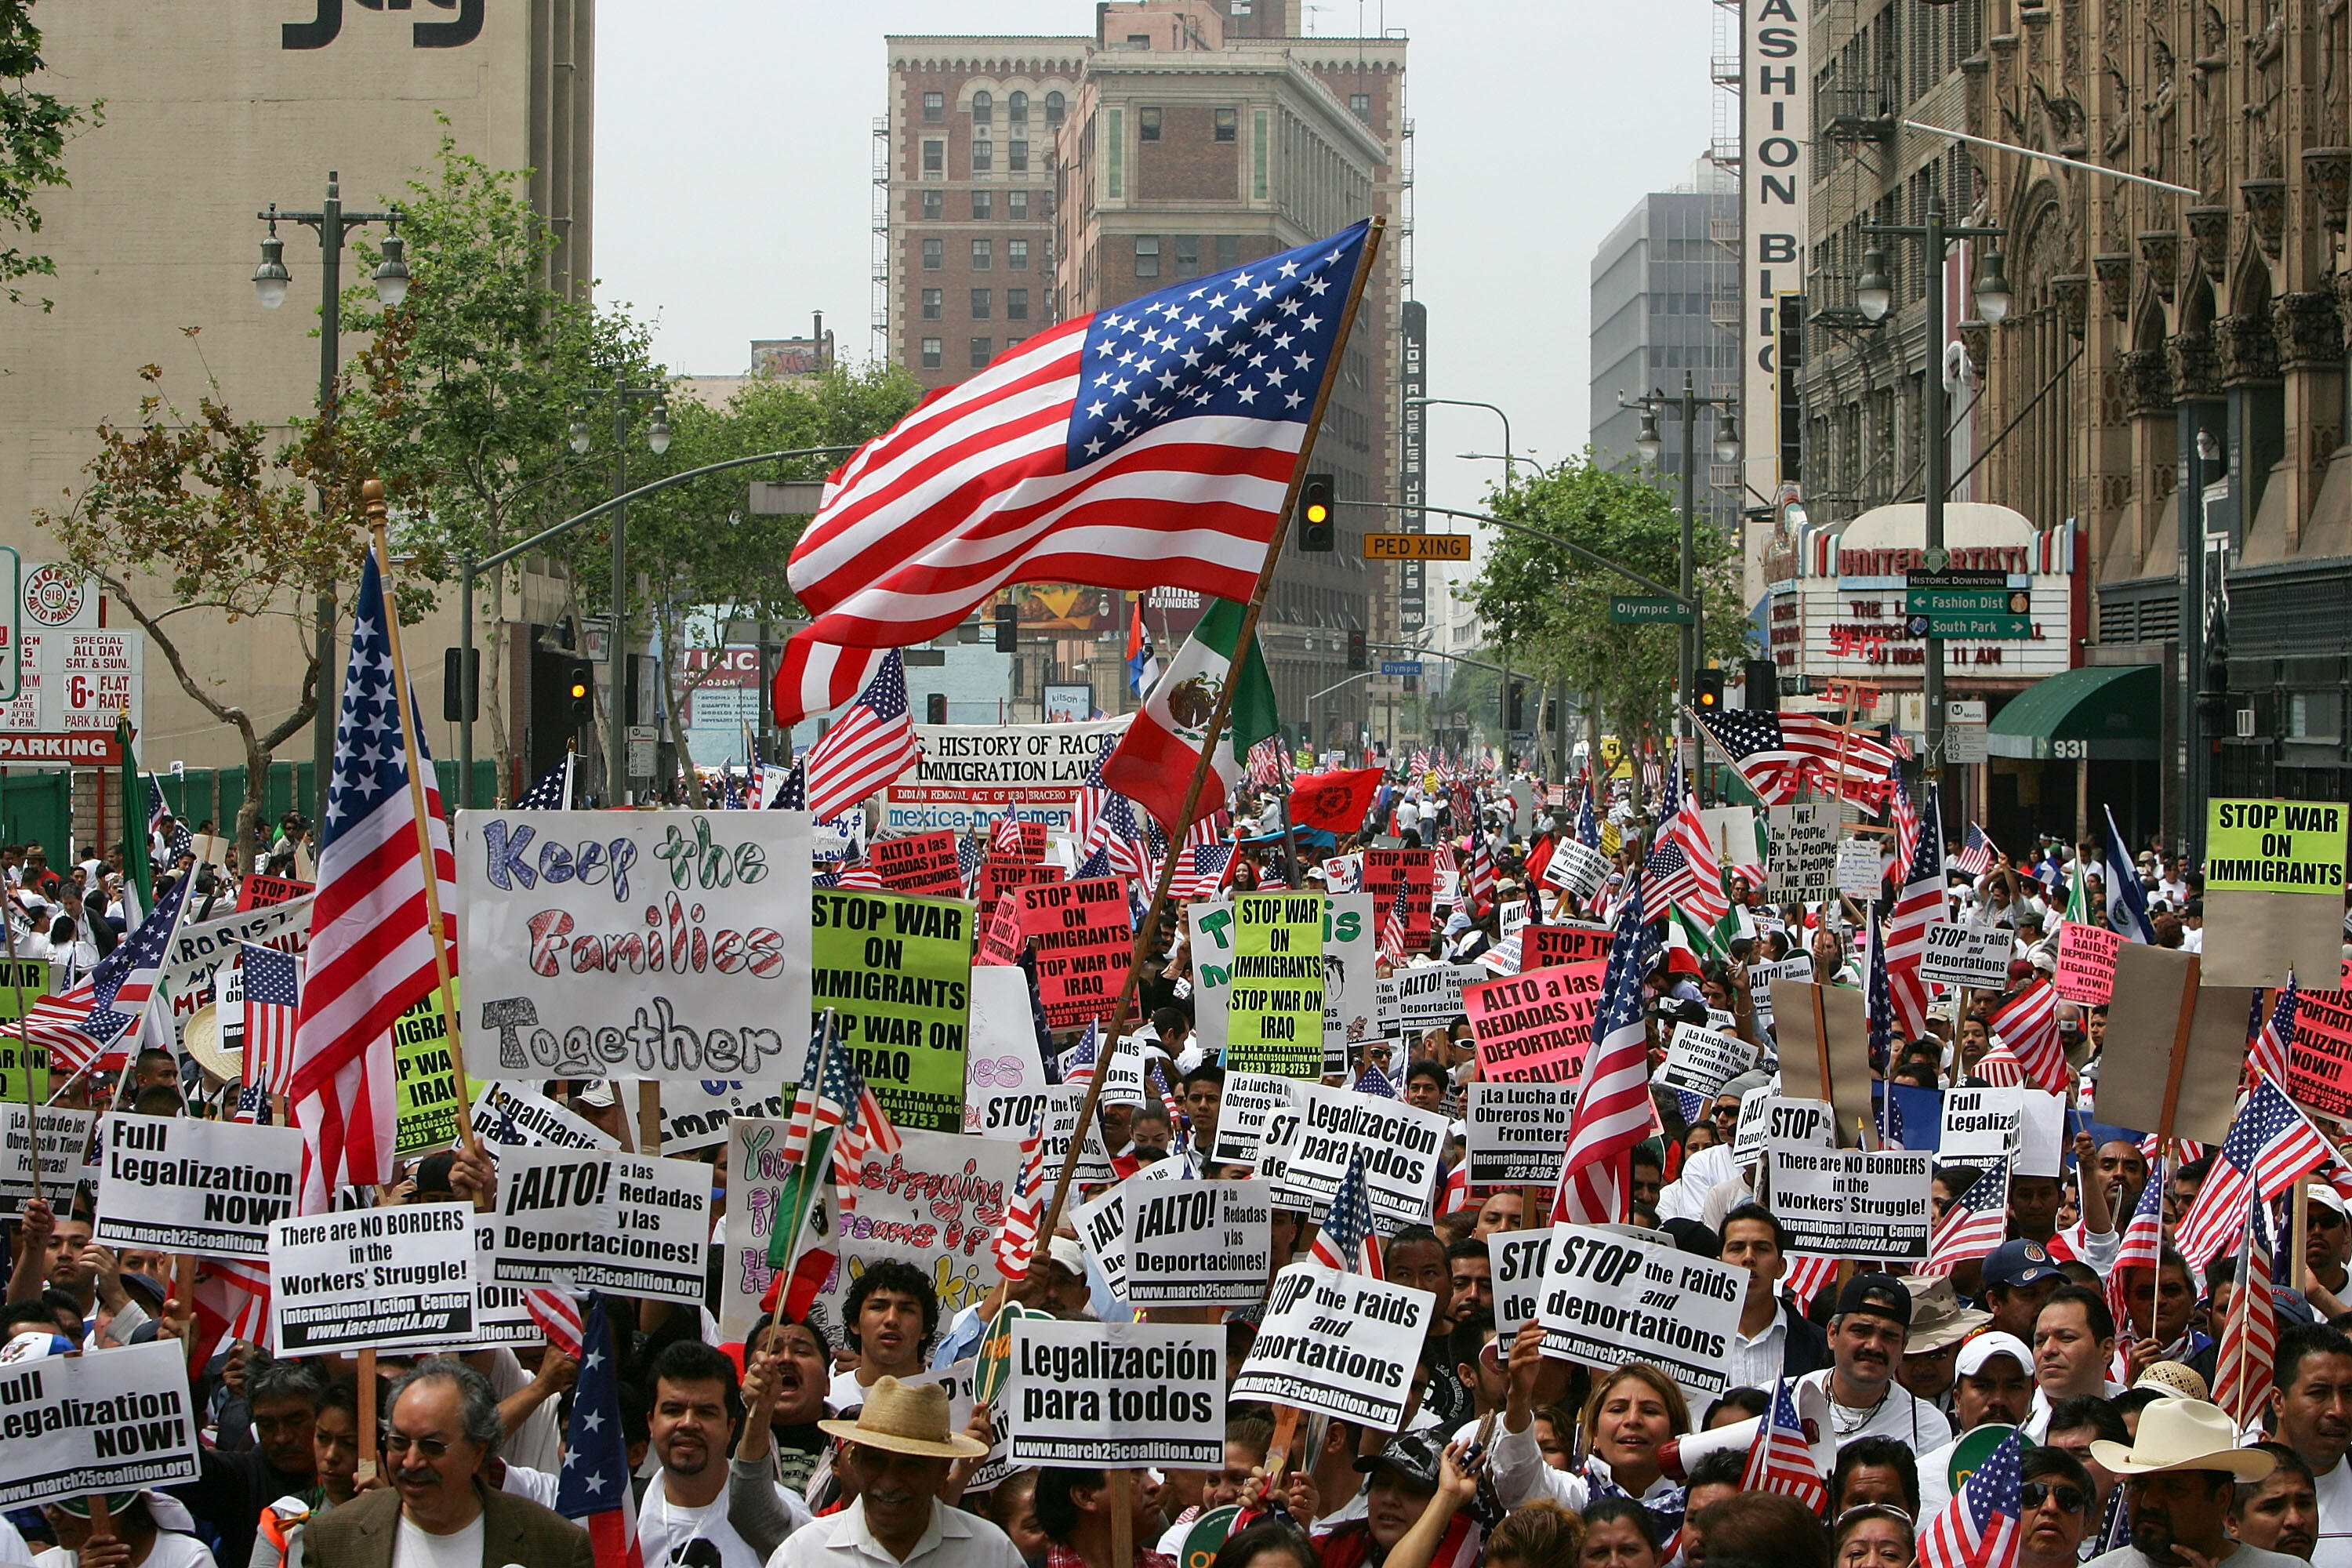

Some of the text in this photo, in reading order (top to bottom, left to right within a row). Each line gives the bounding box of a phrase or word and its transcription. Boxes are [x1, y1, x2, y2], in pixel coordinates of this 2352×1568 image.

[1374, 539, 1461, 556] PED XING
[1839, 548, 1924, 575] UNITED
[45, 589, 63, 602] 918
[1149, 597, 1201, 609] POUNDERS
[1933, 596, 2003, 608] Fashion Dist
[27, 596, 80, 622] AUTO PARKS
[1617, 603, 1670, 618] Olympic
[1933, 620, 1997, 633] South Park
[73, 636, 123, 645] SPECIAL
[74, 646, 123, 657] ALL DAY
[66, 659, 129, 669] SAT. SUN.
[1976, 647, 2002, 665] AM
[1385, 665, 1419, 676] Olympic
[100, 676, 129, 691] FLAT
[99, 693, 129, 709] RATE
[1052, 691, 1078, 704] kitson
[65, 715, 90, 728] PARK
[0, 739, 107, 757] PARKING
[938, 734, 1054, 757] HISTORY OF
[2054, 739, 2088, 758] 931
[916, 761, 1047, 782] IMMIGRATION
[898, 789, 968, 800] INDIAN REMOVAL
[1029, 789, 1066, 800] BRACERO
[2220, 804, 2339, 833] STOP WAR
[880, 837, 947, 861] ALTO a las
[2261, 833, 2292, 858] ON
[484, 815, 769, 902] Keep the
[1369, 853, 1430, 867] STOP WAR
[991, 868, 1055, 883] STOP THE
[1805, 873, 1824, 887] NEED
[2209, 858, 2343, 886] IMMIGRANTS
[1025, 880, 1120, 909] STOP WAR
[812, 893, 963, 941] STOP WAR
[1062, 908, 1087, 927] ON
[1243, 898, 1319, 924] STOP WAR
[527, 891, 785, 979] Families
[1270, 928, 1290, 953] ON
[1537, 931, 1585, 953] STOP
[1928, 926, 2009, 948] STOP the raids
[2071, 926, 2101, 941] STOP
[864, 937, 902, 971] ON
[1967, 946, 1985, 955] and
[2073, 938, 2108, 956] RAIDS
[1234, 955, 1322, 978] IMMIGRANTS
[1926, 951, 2005, 972] deportations
[1064, 976, 1105, 997] IRAQ
[1399, 971, 1442, 1000] ¡ALTO!
[1483, 973, 1600, 1013] ALTO a las
[1232, 989, 1323, 1012] STOP WAR ON
[1261, 1015, 1294, 1042] IRAQ
[1475, 1000, 1585, 1041] REDADAS y
[482, 996, 782, 1076] Together
[929, 1021, 963, 1051] ON
[1679, 1038, 1716, 1061] Obreros
[1239, 1062, 1311, 1075] (323) 228-2753
[2290, 1048, 2343, 1083] NOW!!
[1508, 1088, 1556, 1105] Lucha
[1949, 1093, 1981, 1112] Full
[2296, 1091, 2347, 1115] 228-2753
[1308, 1096, 1439, 1156] Legalización
[1475, 1107, 1565, 1124] Obreros No
[1770, 1106, 1820, 1140] STOP
[113, 1120, 167, 1152] Full
[1302, 1135, 1346, 1168] para
[1472, 1152, 1536, 1166] International
[1777, 1151, 1926, 1175] There are NO BORDERS
[111, 1152, 293, 1196] Legalization
[1832, 1177, 1869, 1193] in the
[506, 1161, 654, 1216] ¡ALTO! a las
[619, 1182, 703, 1211] Redadas
[205, 1193, 291, 1226] NOW!
[1224, 1206, 1267, 1224] Redadas
[1777, 1191, 1926, 1216] Workers' Struggle!
[618, 1210, 660, 1231] y las
[1135, 1189, 1217, 1244] ¡ALTO!
[280, 1210, 464, 1247] There are NO BORDERS
[1848, 1221, 1926, 1239] Action Center
[349, 1241, 393, 1264] in the
[505, 1225, 699, 1265] Deportaciones!
[1136, 1251, 1266, 1274] Deportaciones!
[1555, 1235, 1737, 1303] STOP the raids
[281, 1259, 467, 1298] Workers' Struggle!
[283, 1293, 469, 1325] International Action Center
[1316, 1287, 1421, 1328] the raids
[1639, 1287, 1679, 1311] and
[307, 1310, 449, 1341] www.iacenterLA.org
[1308, 1315, 1353, 1338] and
[1547, 1287, 1726, 1359] deportations
[1021, 1338, 1218, 1382] Legalización
[1024, 1383, 1213, 1424] para todos
[94, 1418, 185, 1459] NOW!
[1015, 1440, 1220, 1464] www.march25coalition.org
